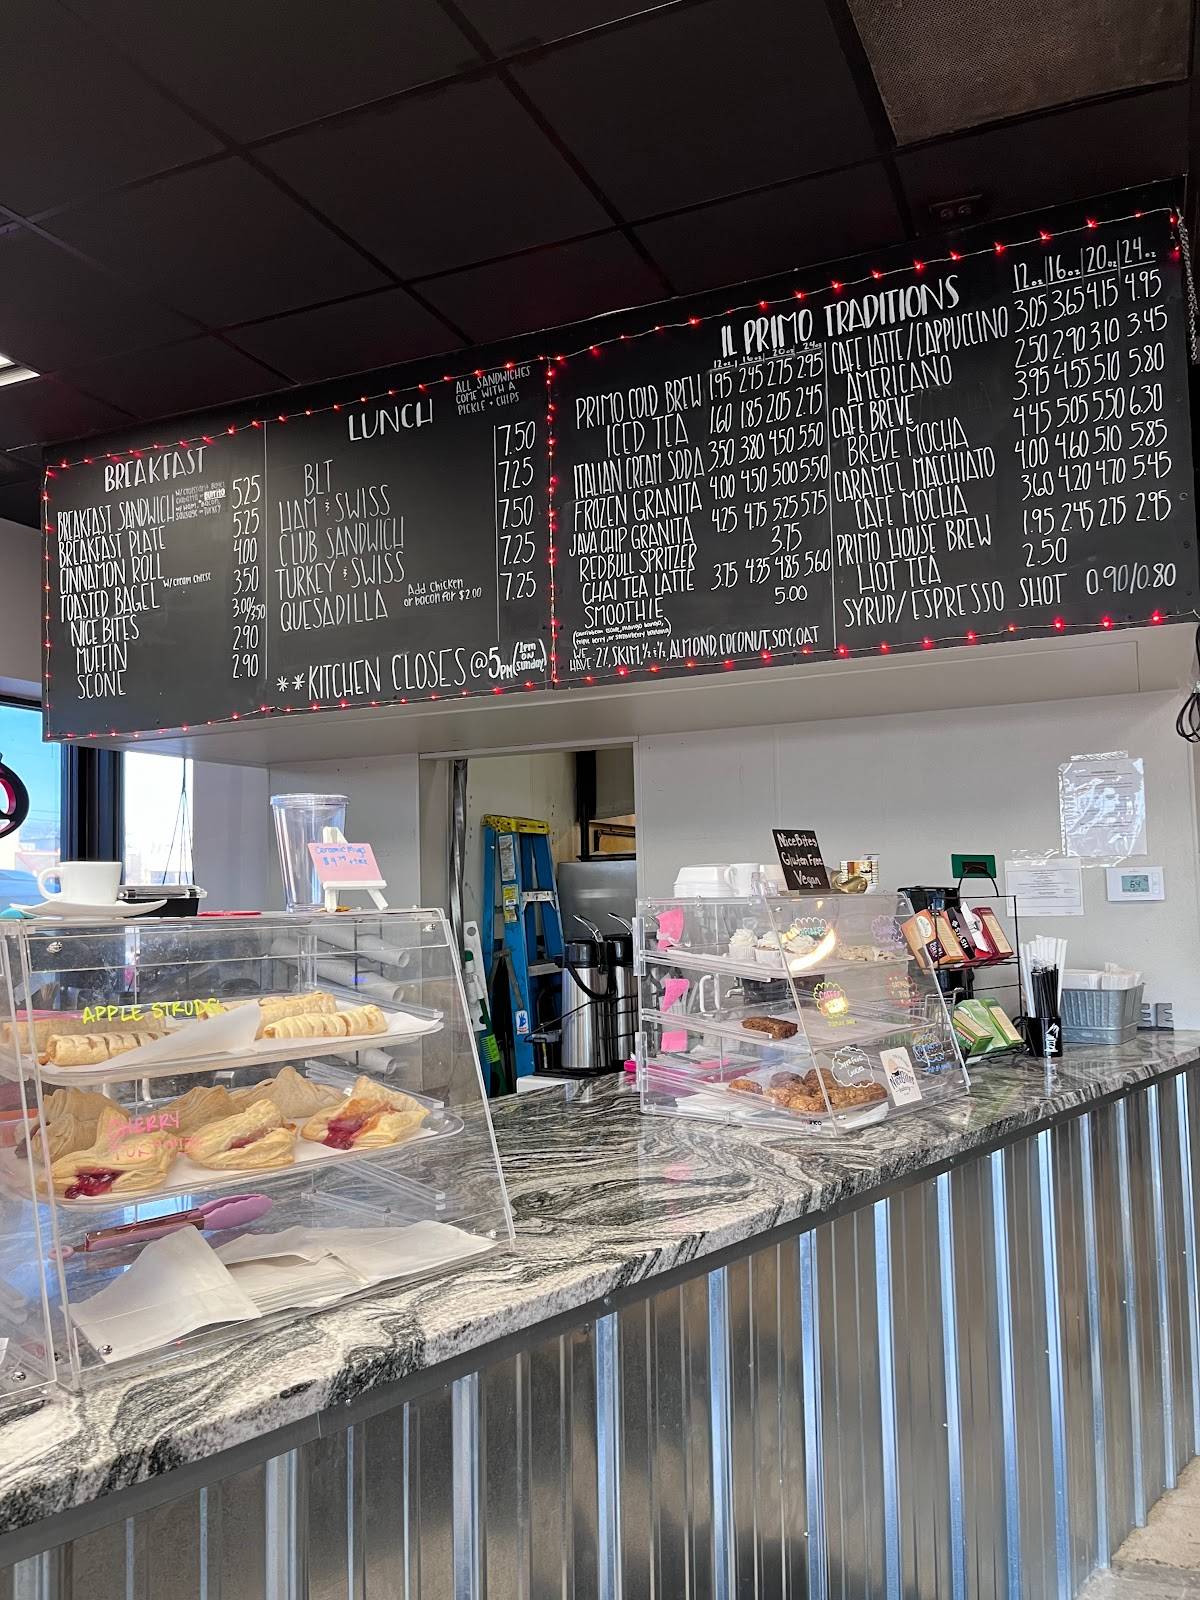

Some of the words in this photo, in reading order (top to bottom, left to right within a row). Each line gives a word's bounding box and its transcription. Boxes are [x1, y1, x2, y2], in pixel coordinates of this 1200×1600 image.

[721, 325, 738, 358] IL
[743, 308, 814, 356] PRIMO
[824, 274, 960, 337] TRADITIONS
[1014, 294, 1047, 332] 3.05
[1050, 286, 1084, 321] 3.65
[1125, 269, 1161, 301] 4.95
[1015, 334, 1047, 368] 2.50
[1053, 326, 1086, 359] 2.90
[1127, 305, 1167, 336] 3.45
[832, 338, 862, 375] CAFE
[1013, 366, 1049, 400] 3.95
[1054, 358, 1090, 389] 4.55
[1094, 351, 1120, 384] 5.10
[1129, 342, 1164, 377] 5.80
[456, 380, 471, 394] ALL
[477, 366, 531, 389] SANDWICHES
[456, 390, 477, 404] COME
[481, 384, 504, 398] WITH
[509, 381, 516, 390] A
[710, 372, 732, 400] 1.95
[797, 353, 824, 378] 2.95
[846, 355, 952, 404] AMERICANO
[458, 400, 486, 416] PICKLE
[496, 392, 520, 406] CHIPS
[576, 392, 624, 430] PRIMO
[629, 385, 658, 420] COLD
[665, 374, 701, 414] BREW
[710, 403, 732, 434] 1.60
[742, 397, 762, 428] 1.85
[796, 384, 822, 417] 2.45
[832, 402, 864, 438] CAFE
[870, 394, 914, 432] BREVE
[1130, 384, 1162, 415] 6.30
[348, 399, 433, 441] LUNCH
[498, 421, 536, 456] 7.50
[607, 420, 645, 458] ICED
[652, 413, 689, 450] TEA
[708, 439, 734, 472] 3.50
[739, 433, 765, 463] 3.80
[848, 429, 900, 466] BREVE
[906, 417, 969, 456] MOCHA
[1015, 437, 1048, 469] 4.00
[1055, 430, 1088, 459] 4.60
[1092, 425, 1122, 454] 5.10
[1129, 419, 1168, 449] 5.85
[104, 446, 207, 492] BREAKFAST
[304, 460, 333, 497] BLT
[498, 457, 534, 492] 7.25
[574, 458, 622, 500] ITALIAN
[626, 453, 662, 490] CREAM
[668, 447, 704, 481] SODA
[710, 474, 735, 500] 4.00
[740, 466, 767, 492] 4.50
[800, 454, 828, 482] 5.50
[834, 462, 906, 502] CARAMEL
[913, 447, 996, 490] MACCHIATO
[1021, 472, 1054, 500] 3.60
[1058, 462, 1091, 492] 4.20
[1096, 458, 1126, 485] 4.70
[1132, 451, 1172, 480] 5.45
[232, 474, 260, 509] 5.25
[279, 498, 317, 534] HAM
[336, 484, 390, 522] SWISS
[575, 494, 627, 532] FROZEN
[633, 481, 702, 520] GRANITA
[855, 495, 893, 530] CAFE
[902, 484, 968, 524] MOCHA
[58, 505, 111, 541] BREAKFAST
[118, 494, 174, 530] SANDWICH
[233, 508, 259, 538] 5.25
[499, 496, 534, 529] 7.50
[744, 502, 767, 530] 4.75
[773, 495, 798, 522] 5.25
[1023, 508, 1054, 535] 1.95
[1061, 500, 1094, 532] 2.45
[1098, 496, 1126, 526] 2.75
[1136, 490, 1171, 521] 2.95
[60, 534, 121, 568] BREAKFAST
[129, 526, 166, 556] PLATE
[234, 538, 258, 564] 4.00
[279, 530, 318, 566] CLUB
[326, 516, 404, 560] SANDWICH
[500, 532, 536, 565] 7.25
[569, 532, 598, 556] JAVA
[600, 527, 628, 552] CHIP
[631, 516, 694, 549] GRANITA
[770, 522, 802, 555] 3.75
[837, 532, 880, 566] PRIMO
[888, 522, 936, 558] HOUSE
[946, 514, 991, 551] BREW
[1022, 538, 1066, 567] 2.50
[60, 558, 125, 594] CINNAMON
[132, 553, 164, 583] ROLL
[234, 566, 258, 594] 3.50
[275, 560, 336, 600] TURKEY
[352, 551, 404, 588] SWISS
[580, 552, 634, 582] REDBULL
[639, 543, 698, 574] SPRITZER
[711, 562, 738, 590] 3.75
[857, 560, 898, 594] HOT
[904, 554, 941, 587] TEA
[1086, 562, 1176, 594] 0.90/0.80
[60, 588, 108, 622] TOASTED
[115, 583, 160, 615] BAGEL
[404, 598, 413, 606] or
[459, 587, 482, 600] $2.00
[408, 582, 426, 596] Add
[500, 572, 536, 600] 7.25
[582, 579, 616, 605] CHAI
[622, 575, 648, 599] TEA
[654, 569, 695, 596] LATTE
[774, 585, 808, 604] 5.00
[1019, 573, 1068, 608] SHOT
[280, 589, 388, 632] QUESADILLA
[585, 597, 664, 628] SMOOTHIE
[70, 617, 98, 647] NICE
[103, 614, 140, 644] BITES
[232, 625, 258, 650] 2.90
[796, 626, 820, 645] OAT
[76, 642, 127, 674] MUFFIN
[232, 654, 258, 678] 2.90
[392, 648, 466, 690] CLOSES
[78, 670, 126, 700] SCONE
[781, 852, 809, 867] Gluten
[794, 870, 821, 888] Vegan
[82, 1006, 144, 1024] APPLE
